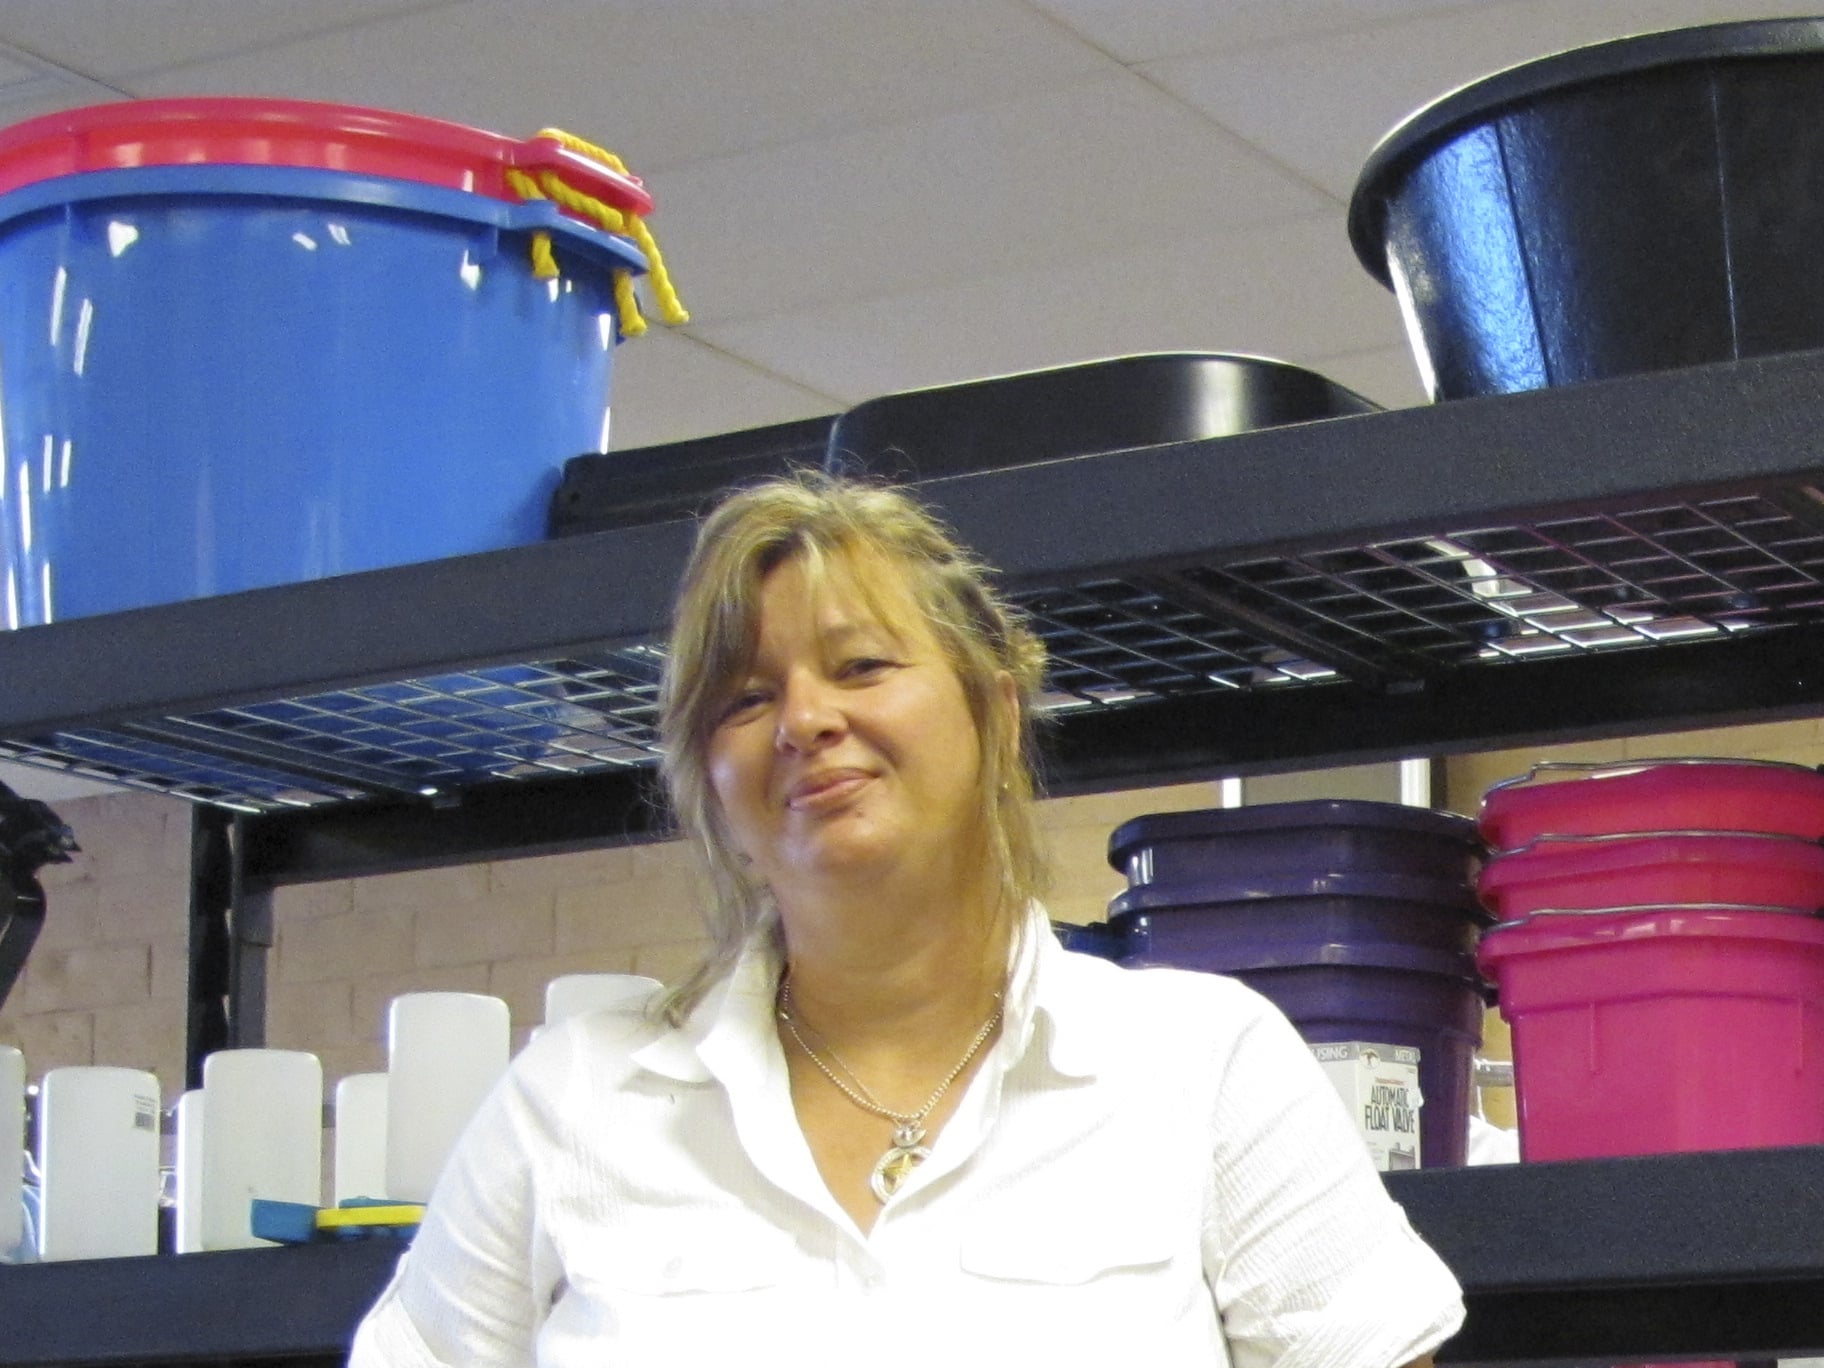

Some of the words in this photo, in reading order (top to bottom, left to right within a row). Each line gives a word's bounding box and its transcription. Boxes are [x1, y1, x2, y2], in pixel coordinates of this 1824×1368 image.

[1370, 1085, 1410, 1108] AUTOMATIC
[1365, 1104, 1389, 1131] FLOAT
[1391, 1106, 1415, 1134] VALVE
